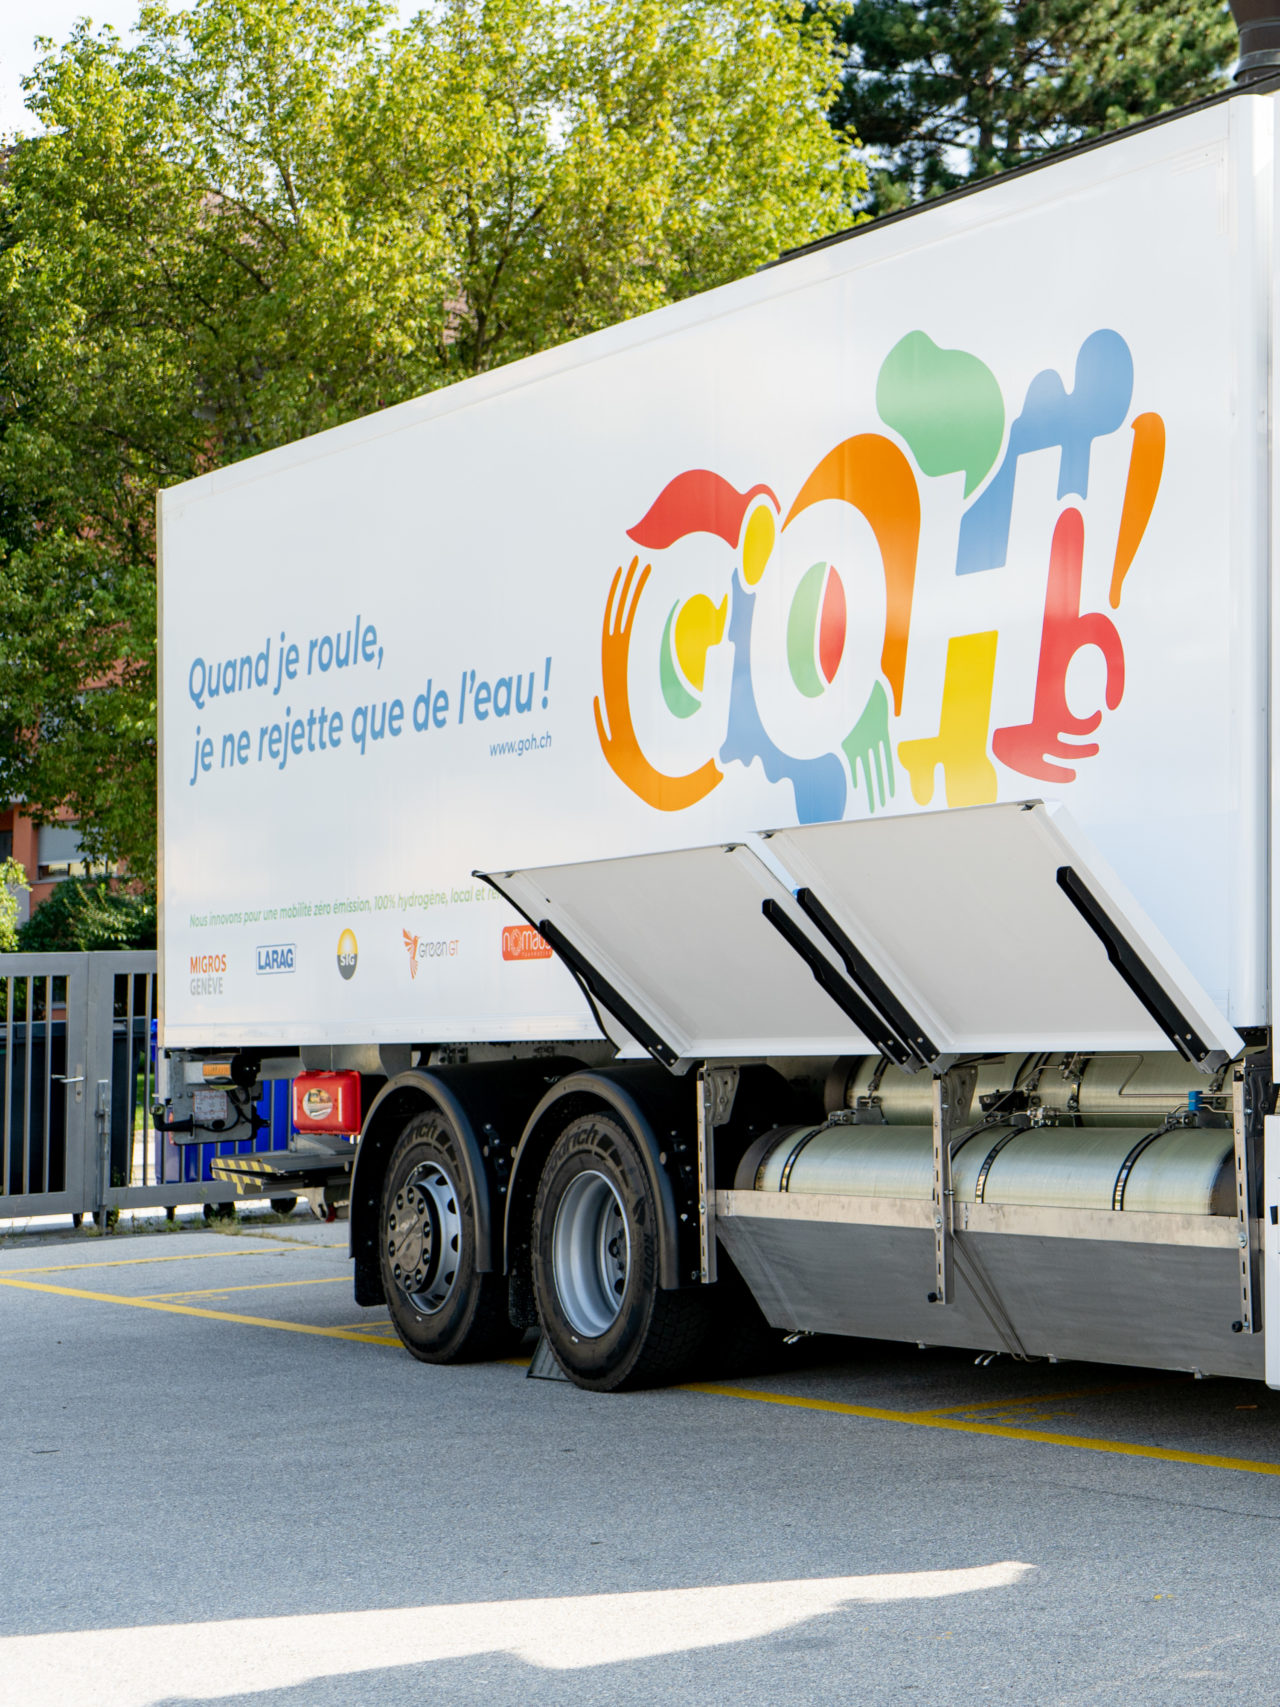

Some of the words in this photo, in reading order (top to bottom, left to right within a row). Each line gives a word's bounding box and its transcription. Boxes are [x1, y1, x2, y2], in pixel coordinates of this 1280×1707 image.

[188, 637, 271, 710] Quand
[272, 631, 300, 696] je
[307, 614, 384, 676] roule,
[189, 725, 213, 786] je
[221, 728, 251, 769] ne
[258, 706, 344, 770] rejette
[351, 698, 405, 756] que
[412, 678, 449, 733] de
[488, 730, 553, 757] www.goh.ch
[189, 913, 208, 929] Nous
[209, 911, 242, 926] innovons
[243, 909, 262, 926] pour
[263, 907, 278, 921] une
[279, 900, 312, 919] mobilité
[313, 899, 331, 916] zéro
[333, 895, 372, 914] émission,
[374, 892, 396, 911] 100%
[397, 889, 449, 912] hydrogène,
[450, 885, 474, 904] local
[475, 886, 485, 901] et
[189, 953, 227, 974] MIGROS
[257, 948, 294, 971] LARAG
[339, 954, 355, 967] SIG
[190, 974, 224, 996] GENÈVE
